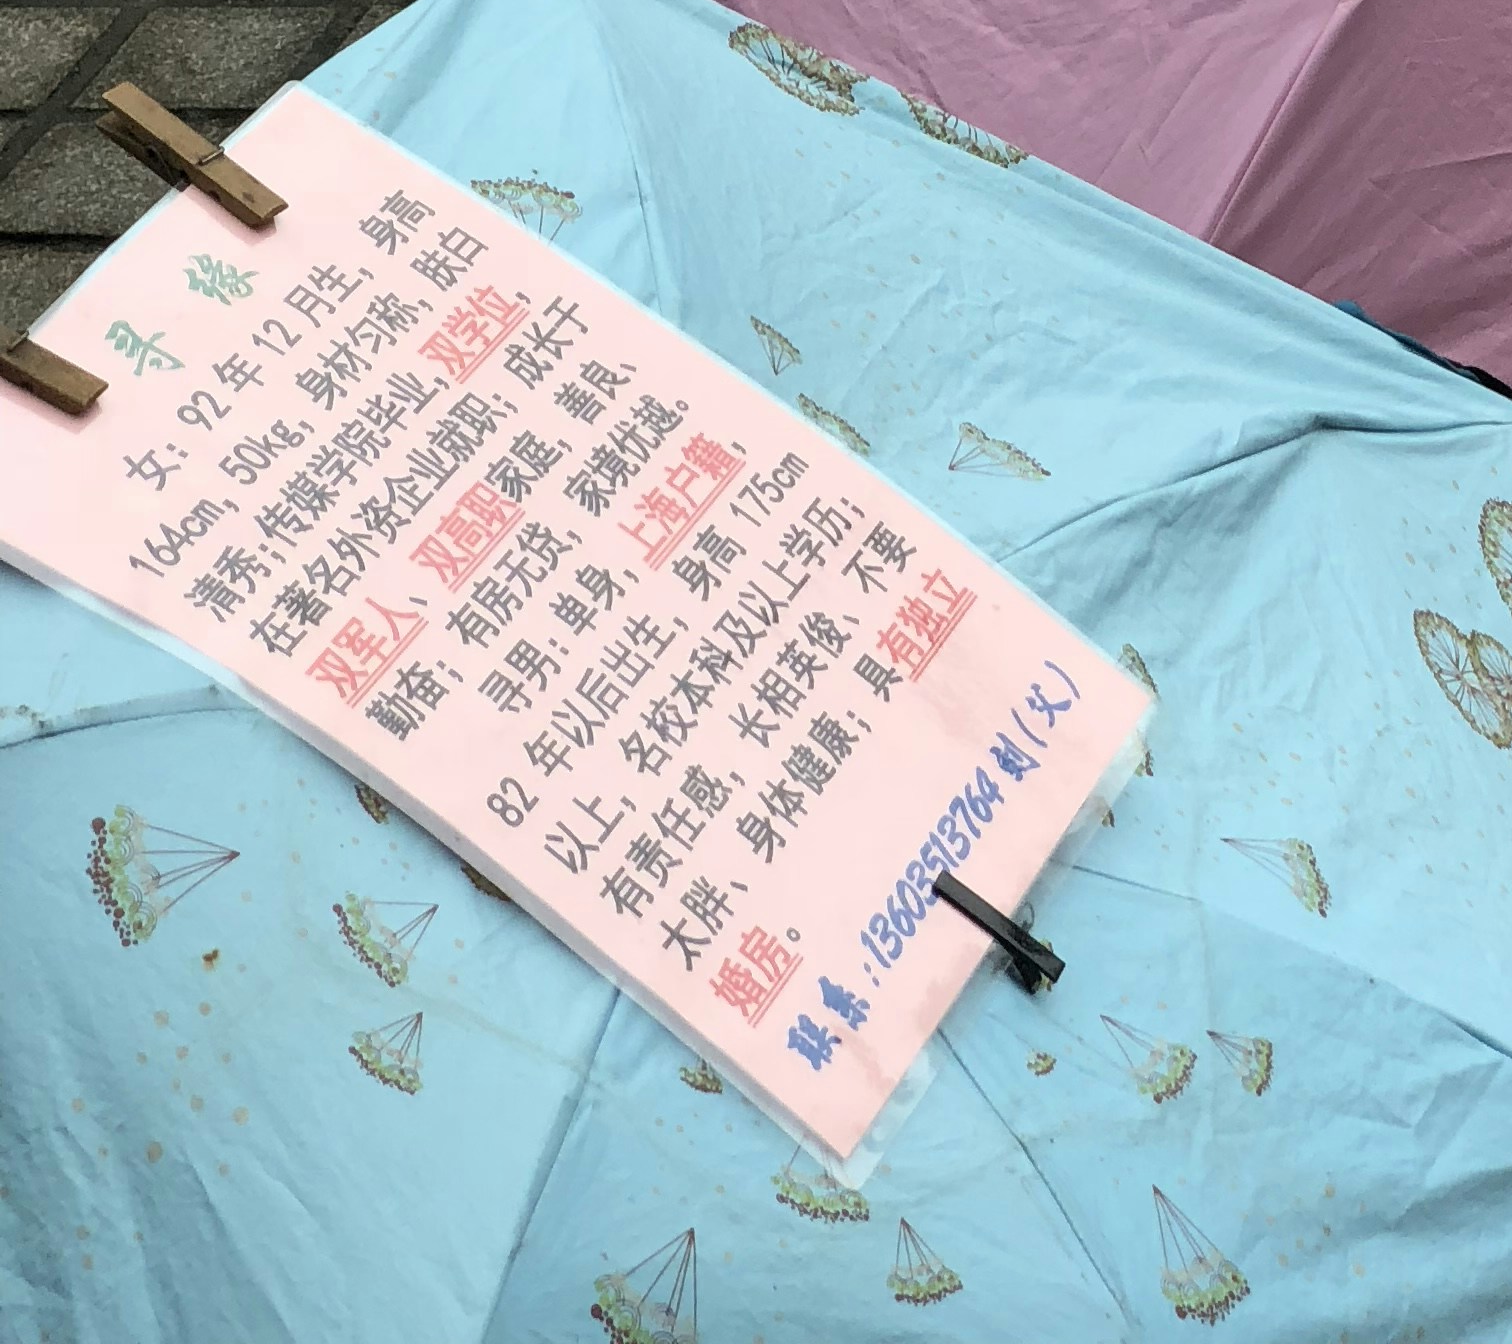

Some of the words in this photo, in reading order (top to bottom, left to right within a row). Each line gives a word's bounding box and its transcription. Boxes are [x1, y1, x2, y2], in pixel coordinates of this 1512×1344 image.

[248, 294, 589, 658] 在著名外资企业就职；成长于
[363, 393, 690, 742] 勤奋；有房无贷，家境优越。
[542, 495, 866, 875] 以上，名校本科及以上学历；
[598, 519, 918, 919] 有责任感，长相英俊、不要
[707, 924, 801, 1024] 婚房。
